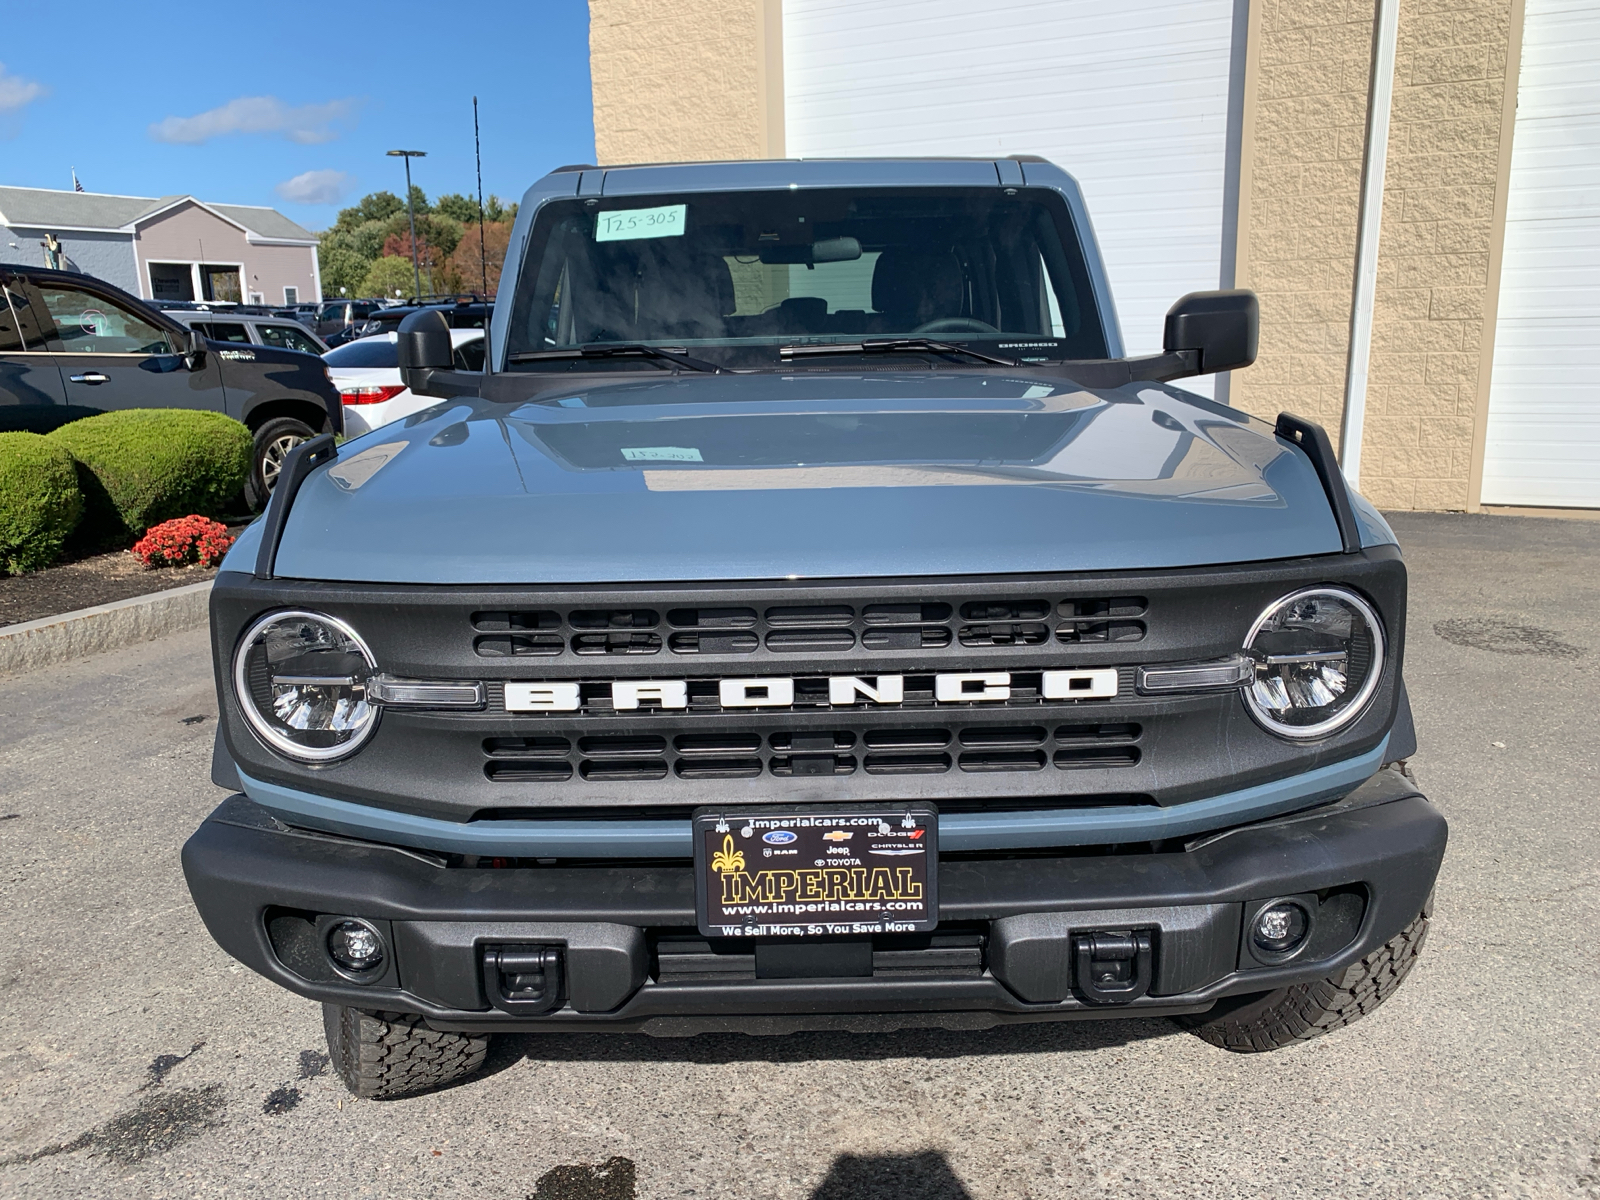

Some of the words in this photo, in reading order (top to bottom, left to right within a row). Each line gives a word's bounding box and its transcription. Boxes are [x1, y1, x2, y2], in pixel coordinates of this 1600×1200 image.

[602, 210, 678, 234] T25-305
[504, 669, 1119, 712] BRONCO
[748, 817, 883, 830] Imperialcars.com
[826, 846, 850, 856] Jeep
[826, 858, 862, 867] TOYOTA
[720, 867, 923, 905] IMPERIAL
[722, 900, 924, 916] www.imperialcars.com
[722, 925, 742, 936] We
[744, 924, 768, 936] Sell
[770, 923, 805, 937] More,
[807, 922, 824, 934] So
[826, 922, 850, 935] You
[852, 921, 883, 933] Save
[885, 920, 916, 932] More
